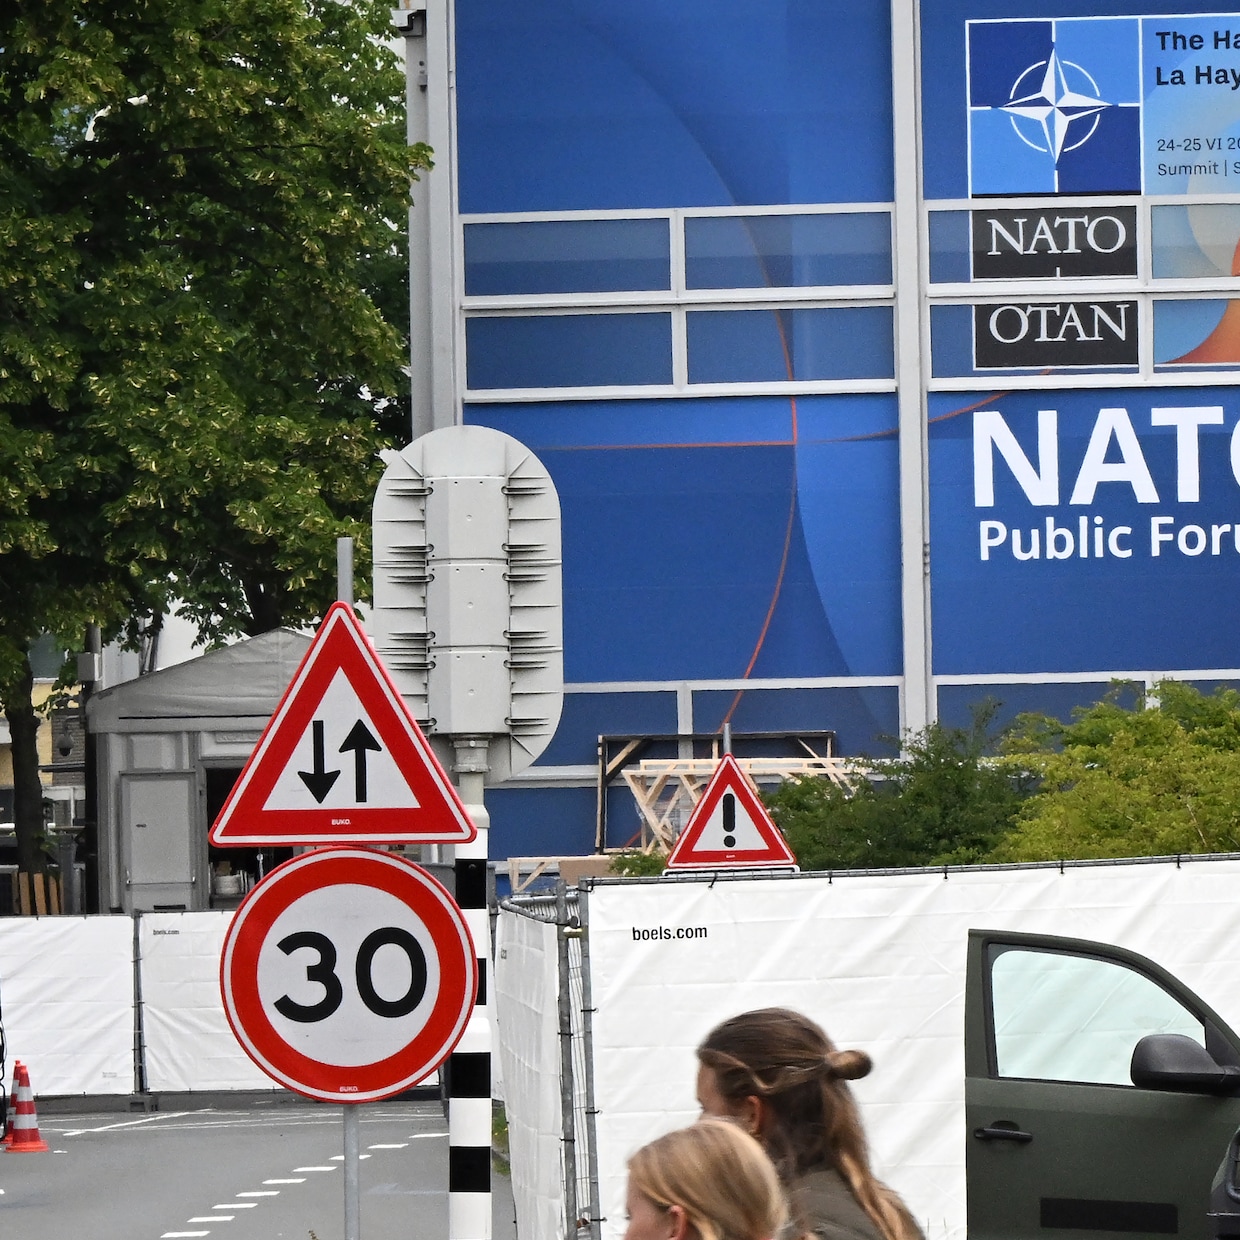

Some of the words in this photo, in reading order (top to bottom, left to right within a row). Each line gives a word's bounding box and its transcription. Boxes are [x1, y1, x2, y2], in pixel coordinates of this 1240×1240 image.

[1155, 30, 1204, 52] The
[1155, 65, 1186, 87] La
[1156, 137, 1202, 153] 24-25
[1205, 137, 1223, 151] VI
[1157, 160, 1219, 176] Summit
[987, 215, 1127, 257] NATO
[988, 303, 1130, 344] OTAN
[979, 516, 1133, 562] Public
[632, 925, 708, 941] boels.com
[273, 926, 428, 1023] 30
